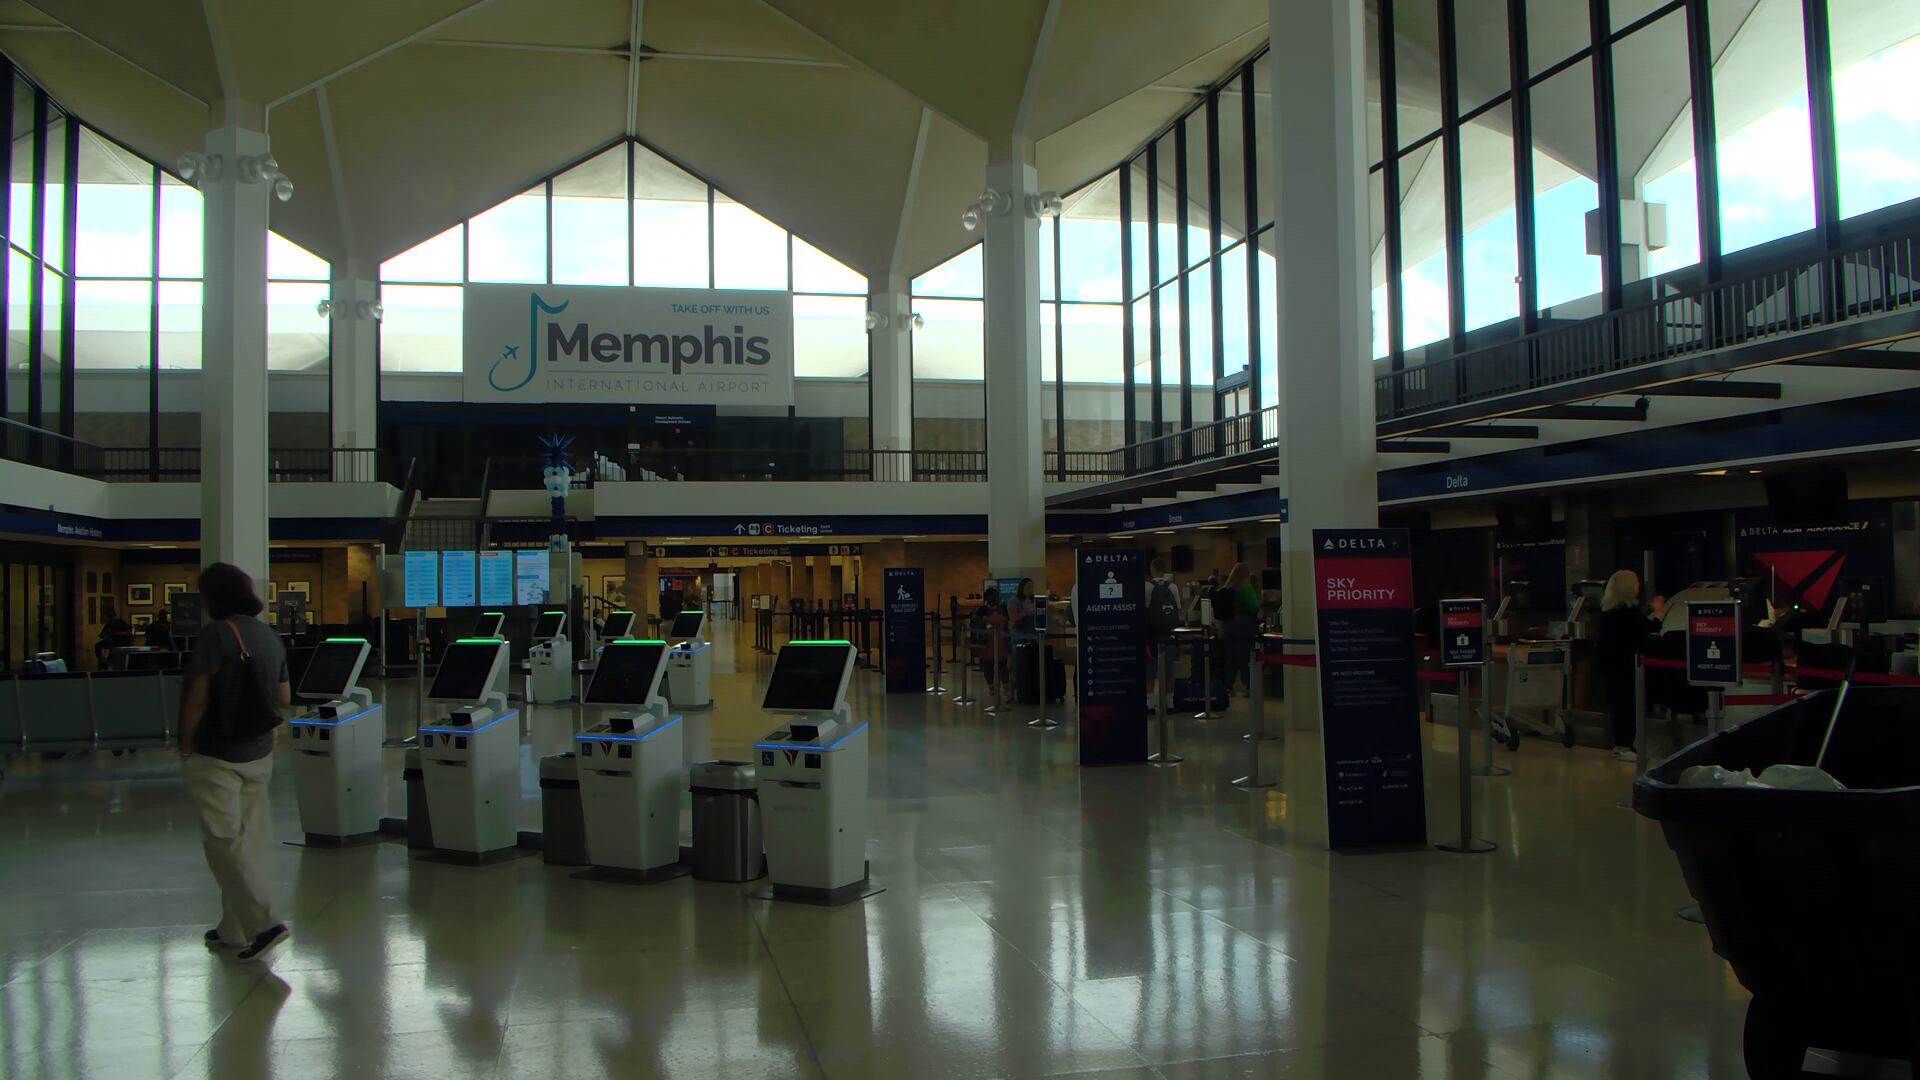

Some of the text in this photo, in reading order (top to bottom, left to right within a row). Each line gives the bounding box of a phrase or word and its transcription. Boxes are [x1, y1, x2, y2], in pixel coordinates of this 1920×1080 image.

[671, 303, 770, 316] TAKE OFF WITH US
[547, 322, 771, 375] Memphis
[546, 378, 770, 394] INTERNATIONAL AIRPORT
[1446, 475, 1469, 489] Delta
[776, 524, 818, 535] Ticketing
[1338, 538, 1385, 549] DELTA
[1095, 554, 1129, 563] DELTA
[1327, 577, 1356, 589] SKY
[1327, 589, 1395, 601] PRIORITY
[1087, 602, 1137, 612] AGENT ASSIST
